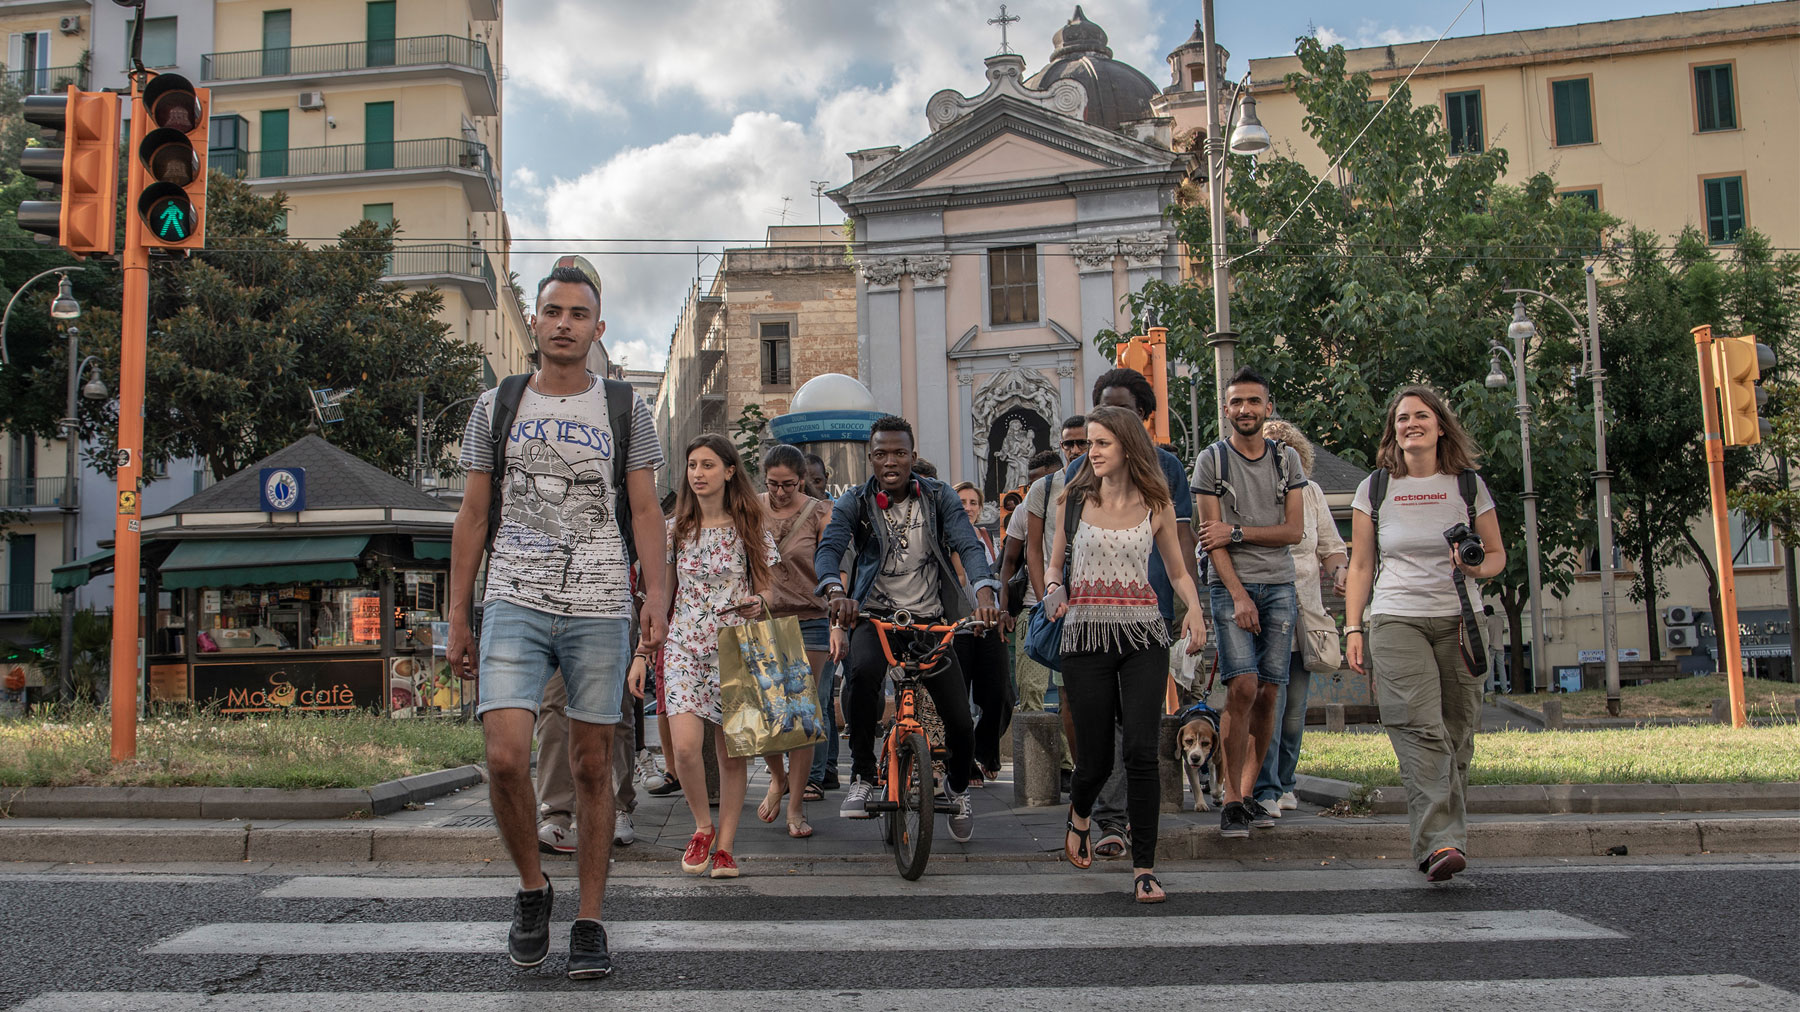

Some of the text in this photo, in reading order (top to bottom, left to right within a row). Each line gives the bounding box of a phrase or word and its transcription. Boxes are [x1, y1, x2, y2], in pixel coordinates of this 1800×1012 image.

[509, 419, 550, 442] UCK
[228, 684, 354, 706] Mo cafè
